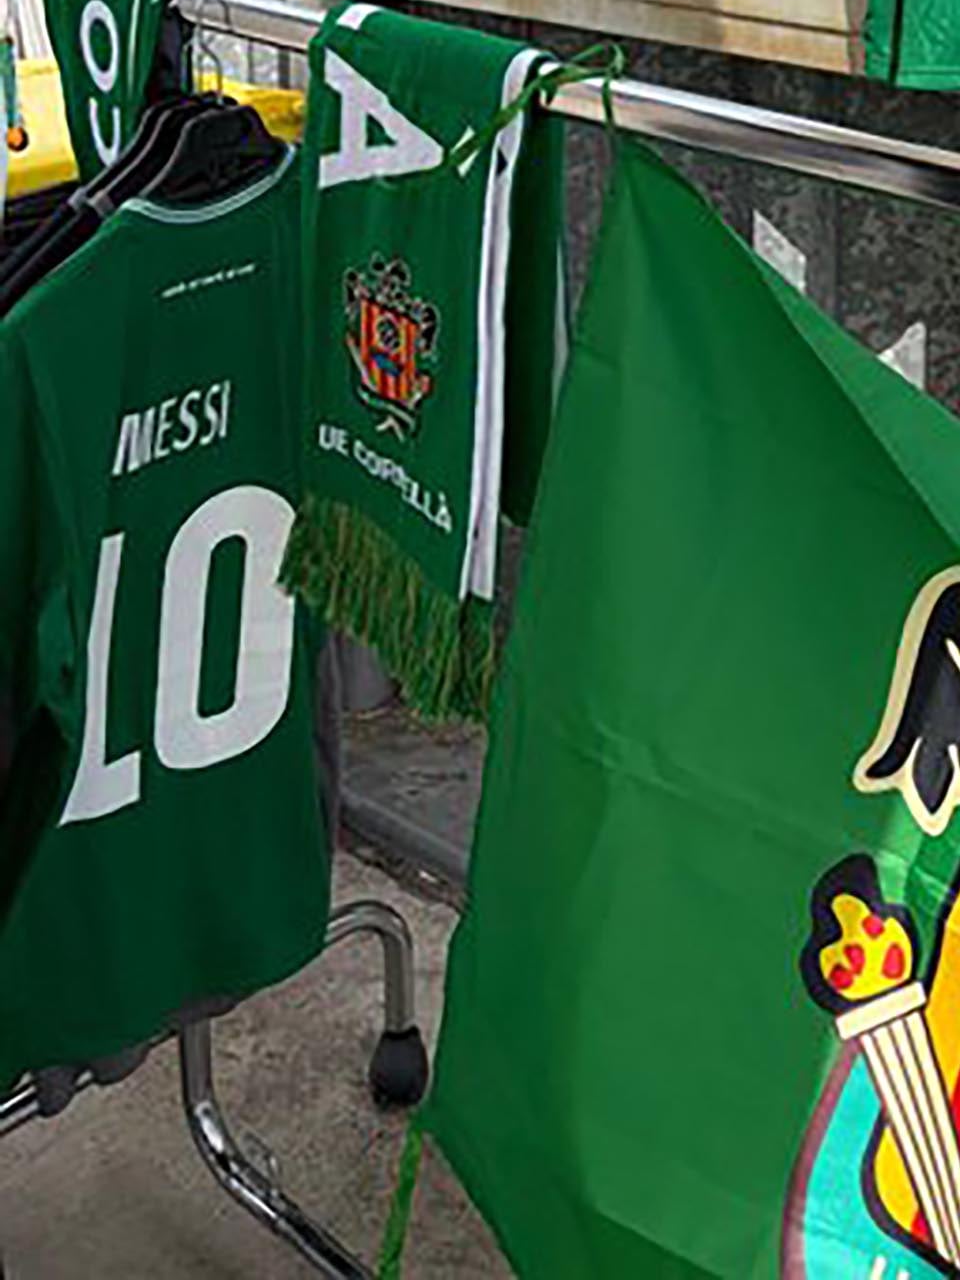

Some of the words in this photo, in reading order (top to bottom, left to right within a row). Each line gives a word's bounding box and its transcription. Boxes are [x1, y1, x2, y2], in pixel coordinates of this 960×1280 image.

[112, 380, 232, 475] MESSI
[318, 424, 350, 458] UE
[58, 485, 297, 827] 10
